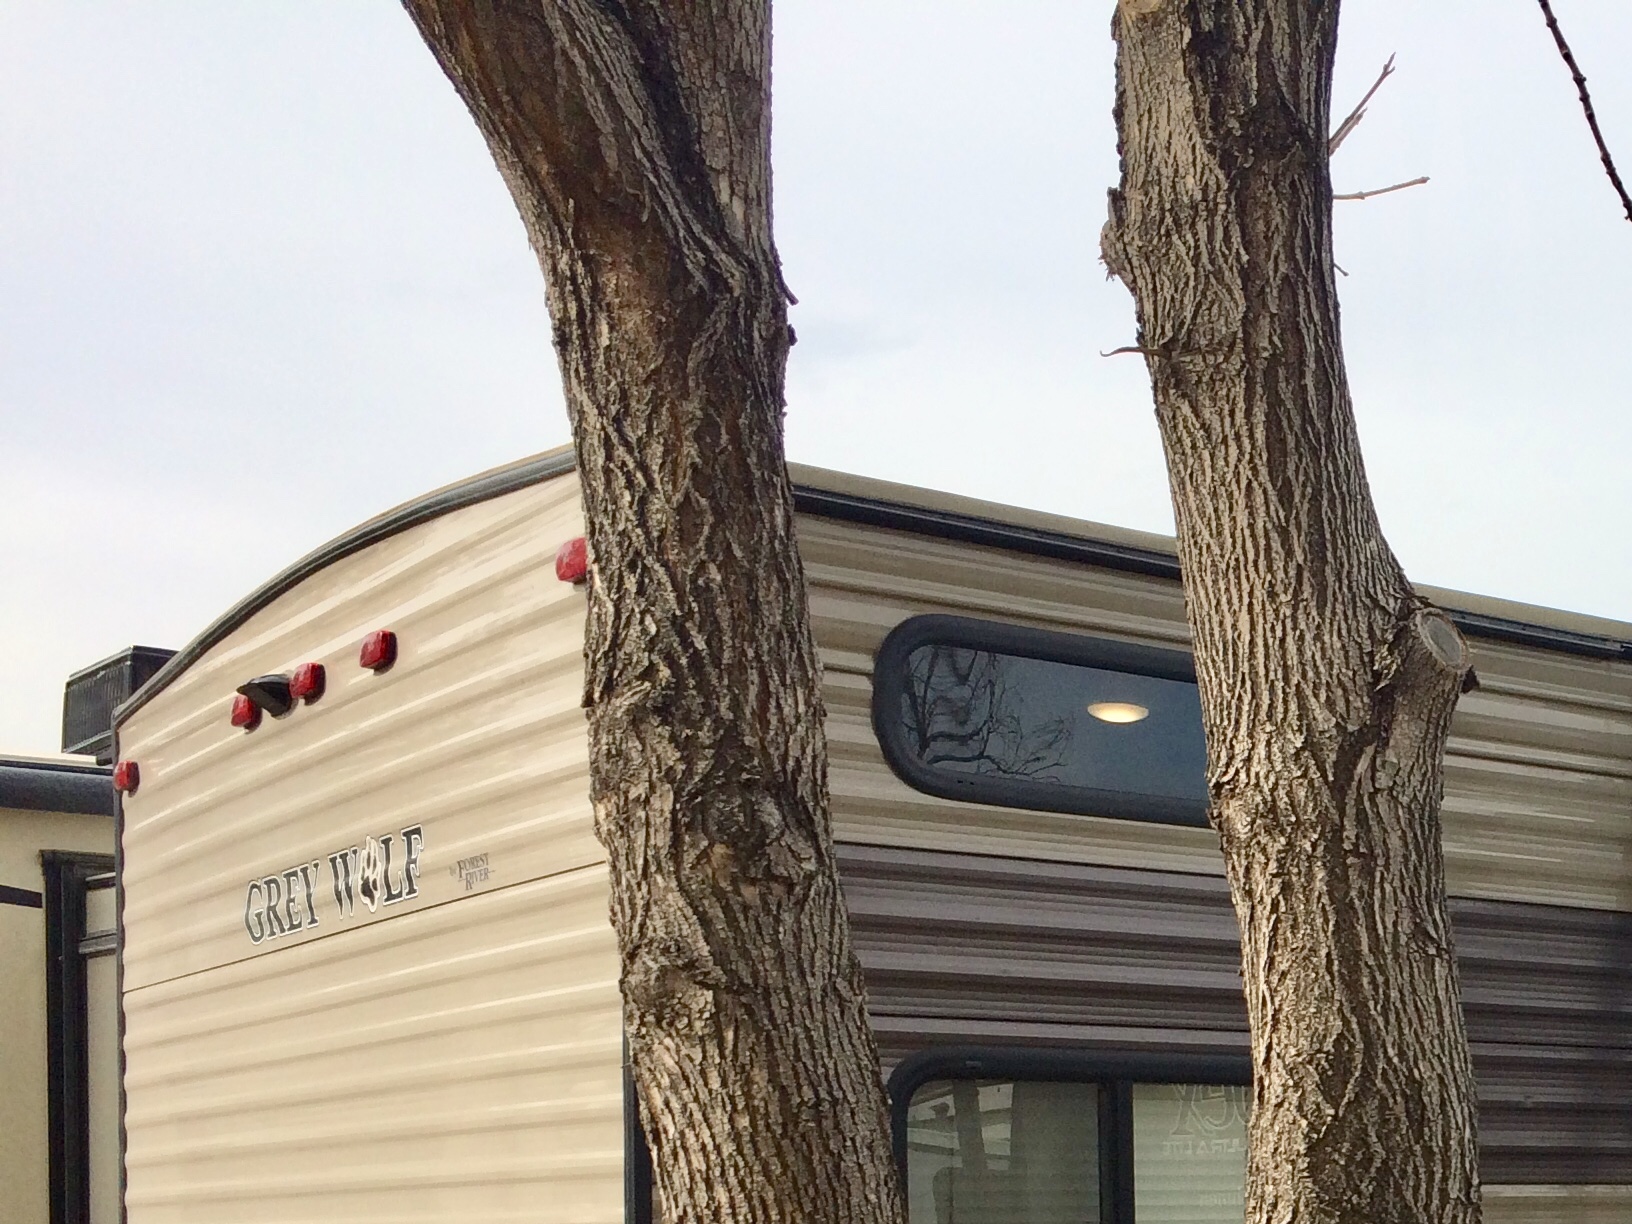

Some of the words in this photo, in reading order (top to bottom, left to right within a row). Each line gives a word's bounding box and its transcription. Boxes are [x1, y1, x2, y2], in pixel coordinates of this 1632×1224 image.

[456, 852, 489, 879] FOREST
[464, 866, 489, 890] RIVER
[244, 859, 321, 945] GREY
[327, 823, 425, 920] WOLF
